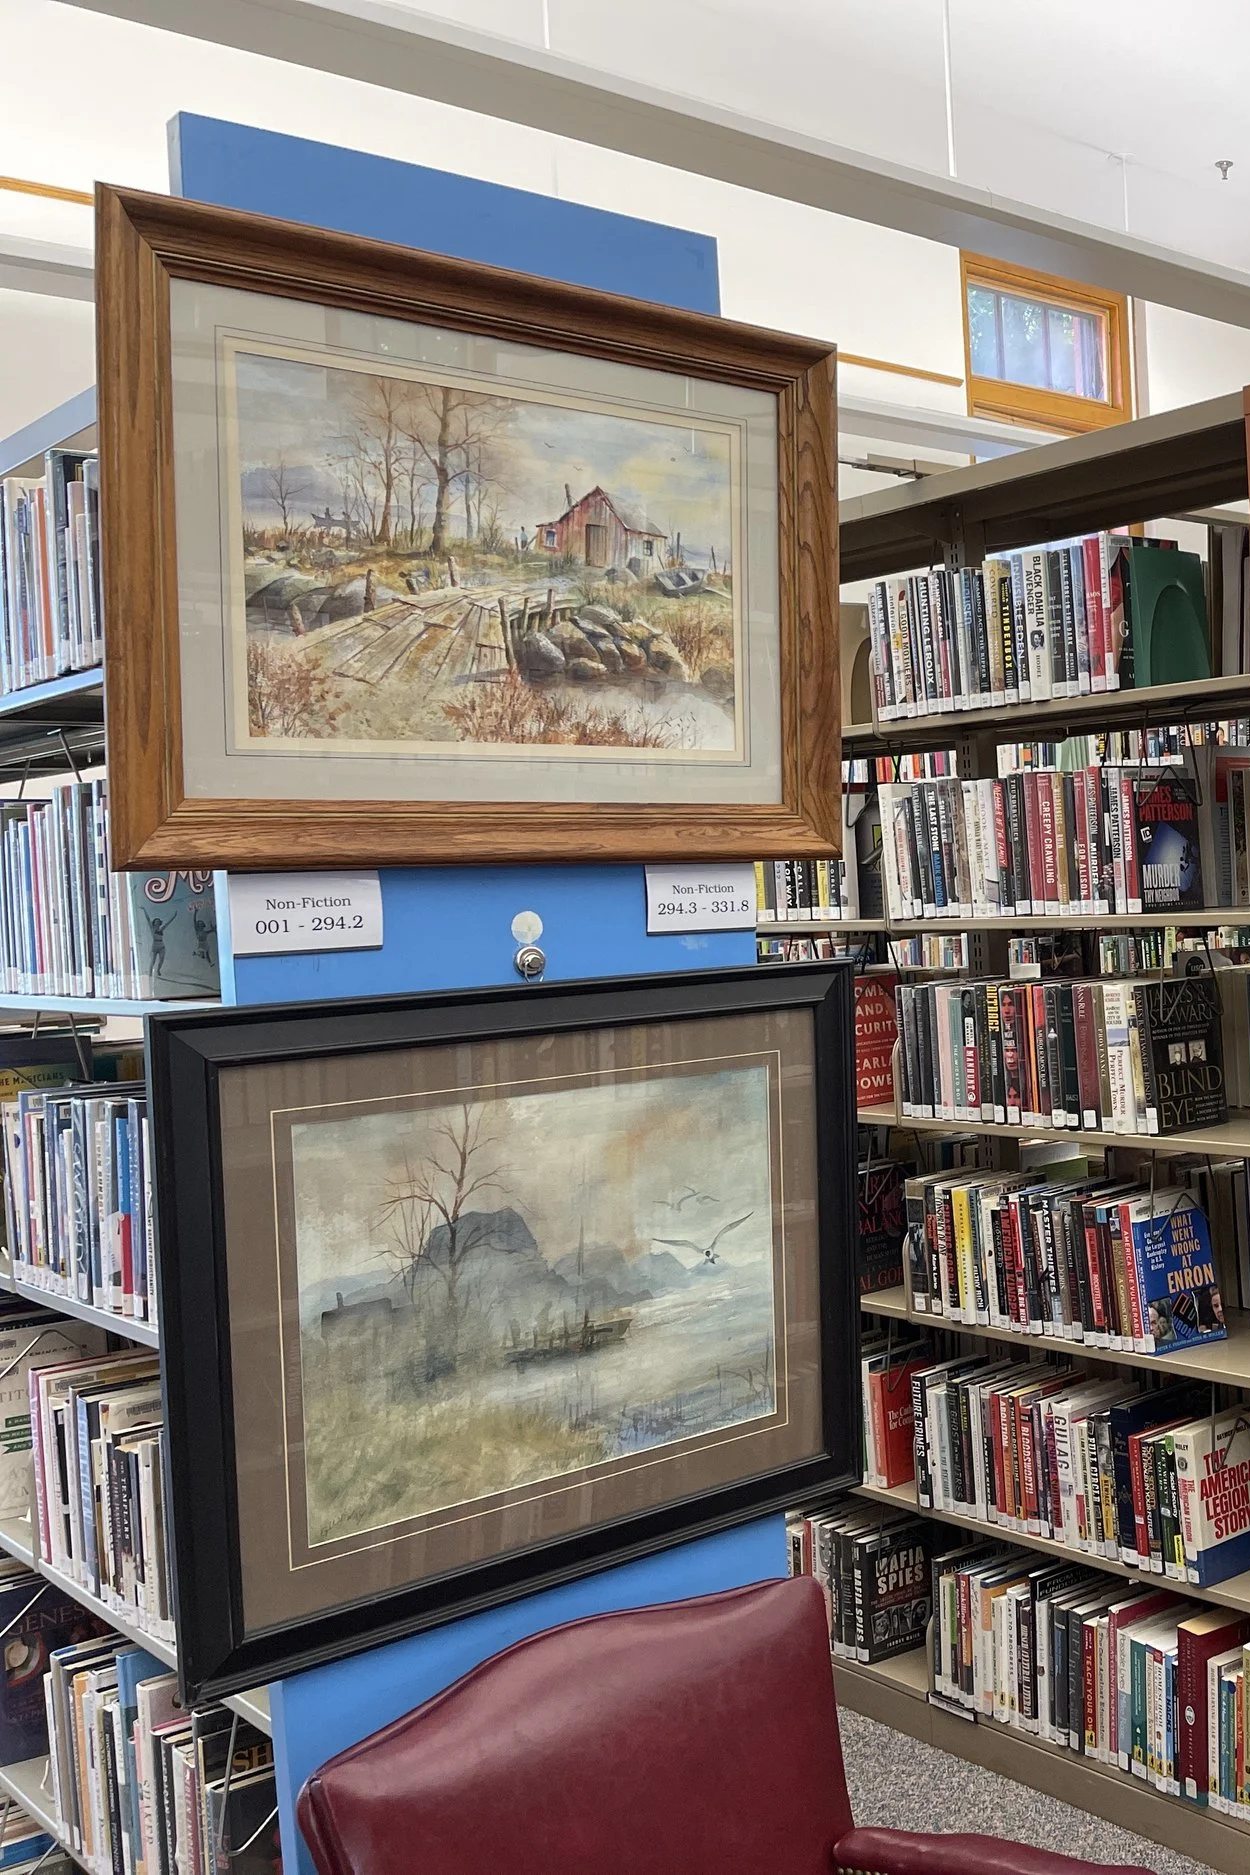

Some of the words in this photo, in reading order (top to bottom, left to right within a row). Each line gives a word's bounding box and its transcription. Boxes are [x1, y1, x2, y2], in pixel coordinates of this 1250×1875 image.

[1032, 555, 1042, 588] BLACK
[1012, 561, 1023, 620] INVISIBLE
[1025, 570, 1035, 615] AVENGER
[919, 581, 930, 635] HUNTING
[1034, 591, 1045, 628] DAHLIA
[900, 613, 908, 639] GOOD
[1002, 604, 1013, 669] TINDERBOX
[1016, 625, 1025, 660] EDEN
[902, 641, 912, 686] MOTHERS
[923, 638, 934, 684] LEROUX
[927, 790, 935, 806] THE
[994, 786, 1003, 815] MEMBER
[1087, 773, 1096, 797] JAMES
[1109, 786, 1118, 813] JAMES
[929, 807, 937, 826] LAST
[1010, 779, 1019, 842] THUNDERSTRUCK
[1042, 800, 1052, 835] CREEPY
[1089, 797, 1098, 835] PATTERSON
[1121, 793, 1130, 819] JAMES
[1139, 803, 1194, 822] PATTERSON
[930, 827, 939, 852] STONE
[1078, 844, 1086, 861] FOR
[1111, 814, 1121, 859] PATTERSON
[1122, 820, 1133, 861] PATTERSON
[933, 853, 941, 875] MARK
[997, 841, 1007, 865] FAMILY
[1044, 838, 1055, 884] CRAWLING
[1090, 842, 1099, 885] MURDER
[672, 882, 734, 895] Non-Fiction
[935, 876, 944, 906] BOWDEN
[1080, 863, 1088, 897] ALISON
[1142, 864, 1181, 889] MURDER
[266, 896, 351, 910] Non-Fiction
[658, 900, 697, 915] 294.3
[711, 899, 749, 913] 331.8
[1143, 889, 1155, 903] THY
[1155, 888, 1180, 902] NEIGHBOR
[255, 920, 290, 934] 001
[311, 915, 364, 932] 294.2
[986, 986, 1000, 1032] OUTRAGE
[1097, 1028, 1105, 1079] PROVENANCE
[1109, 1054, 1117, 1085] PERFECT
[1138, 1029, 1148, 1070] STEWART
[1143, 1072, 1152, 1099] BLIND
[966, 1050, 975, 1091] MANHUNT
[1156, 1065, 1223, 1099] BLIND
[1118, 1084, 1126, 1116] MURDER
[1160, 1098, 1196, 1129] EYE
[944, 1203, 953, 1249] CHASING
[1171, 1213, 1192, 1229] WHAT
[1172, 1227, 1195, 1242] WENT
[1000, 1212, 1015, 1269] AMERICAN
[1042, 1200, 1052, 1244] MASTER
[1047, 1247, 1057, 1293] THIEVES
[1147, 1248, 1167, 1259] Bankruptcy
[1151, 1242, 1166, 1251] Largest
[1171, 1241, 1201, 1257] WRONG
[973, 1266, 981, 1289] FILTHY
[1182, 1255, 1193, 1268] AT
[1123, 1230, 1132, 1266] AMERICA
[1130, 1285, 1140, 1338] VULNERABLE
[1168, 1262, 1215, 1294] ENRON
[976, 1289, 984, 1308] RICH
[912, 1381, 923, 1417] FUTURE
[914, 1420, 925, 1457] CRIMES
[999, 1401, 1008, 1447] ABOLITION
[1054, 1416, 1069, 1470] GULAG
[1088, 1437, 1098, 1464] FULL
[1203, 1447, 1226, 1475] THE
[1090, 1466, 1100, 1503] CIRCLE
[1169, 1471, 1178, 1491] Social
[1181, 1478, 1190, 1516] AMERICAN
[1187, 1480, 1196, 1493] THE
[120, 1478, 130, 1541] TEMPLARS
[1170, 1491, 1179, 1518] Security
[1205, 1484, 1250, 1521] LEGION
[1185, 1517, 1193, 1542] LEGION
[875, 1546, 925, 1578] MAFIA
[854, 1568, 862, 1604] MAFIA
[877, 1566, 924, 1595] SPIES
[856, 1607, 864, 1642] SPIES
[1085, 1655, 1093, 1685] TEACH
